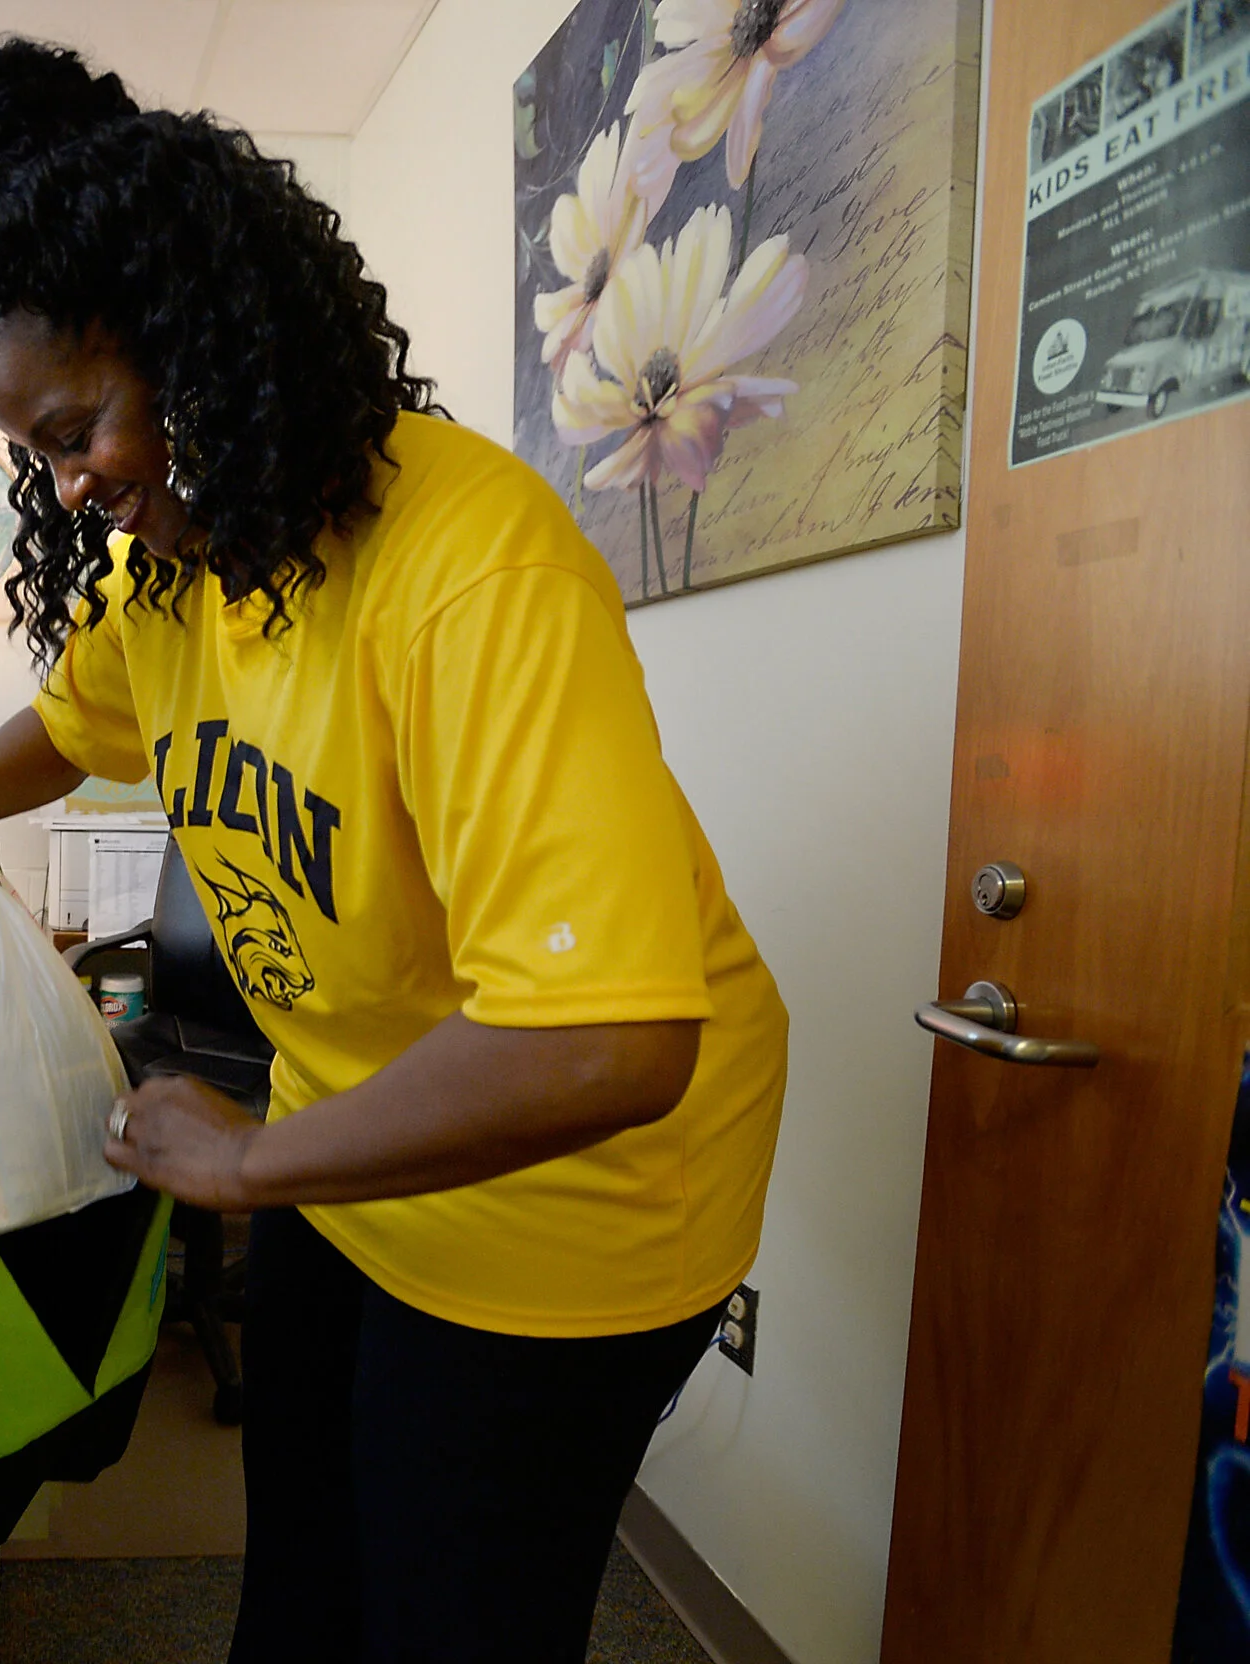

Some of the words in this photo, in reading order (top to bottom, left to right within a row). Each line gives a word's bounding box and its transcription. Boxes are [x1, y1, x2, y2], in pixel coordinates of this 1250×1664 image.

[1029, 155, 1090, 209] KIDS
[1104, 110, 1161, 164] EAT
[154, 719, 341, 925] LION
